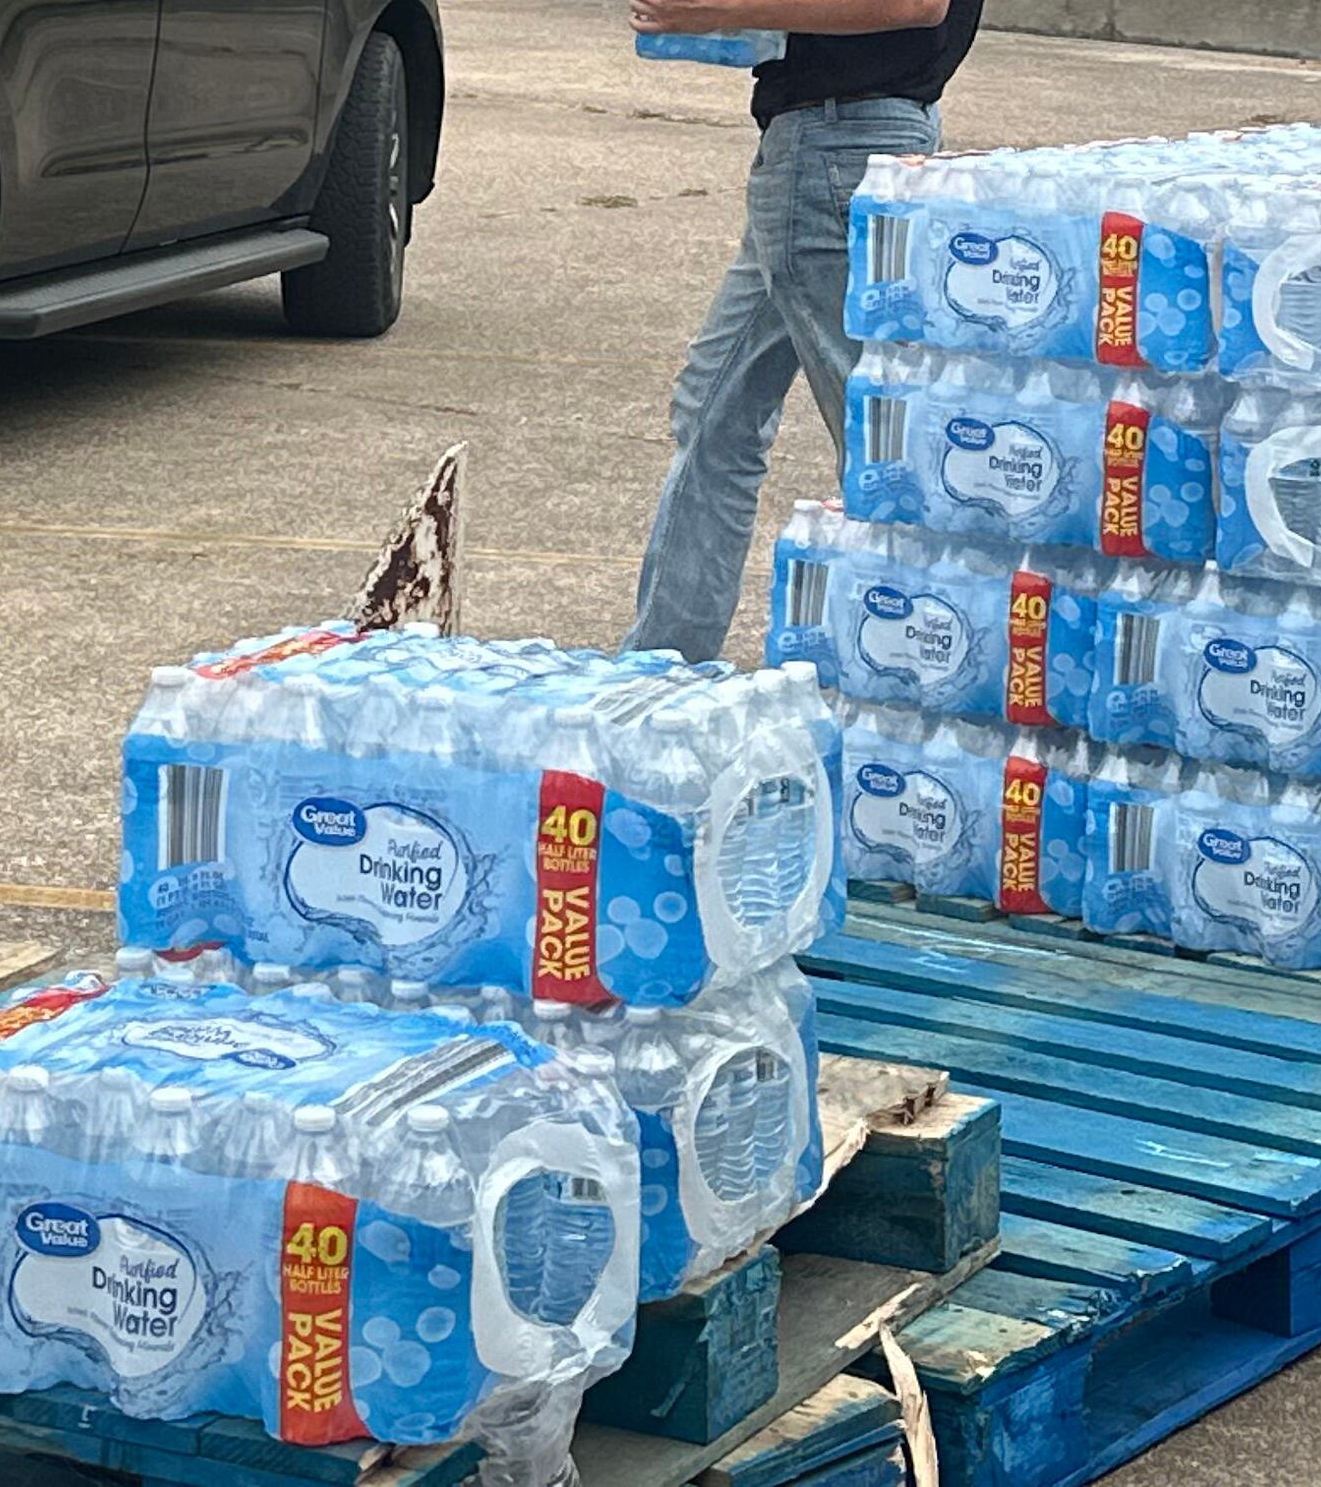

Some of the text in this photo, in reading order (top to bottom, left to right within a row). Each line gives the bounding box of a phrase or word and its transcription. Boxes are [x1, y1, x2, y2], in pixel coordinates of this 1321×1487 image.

[1102, 234, 1137, 260] 40
[1098, 287, 1115, 346] PACK
[1115, 286, 1133, 347] VALUE
[1107, 423, 1144, 450] 40
[1102, 478, 1119, 536] PACK
[1120, 476, 1138, 537] VALUE
[1013, 593, 1046, 620] 40
[1009, 648, 1025, 706] PACK
[1025, 647, 1042, 708] VALUE
[1006, 779, 1040, 806] 40
[301, 805, 356, 827] Great
[314, 824, 356, 837] Value
[541, 805, 596, 846] 40
[360, 855, 441, 891] Drinking
[1003, 834, 1018, 891] PACK
[1019, 833, 1035, 892] VALUE
[381, 883, 443, 910] Water
[538, 889, 563, 979] PACK
[565, 886, 590, 981] VALUE
[26, 1212, 88, 1237] Great
[41, 1232, 87, 1247] Value
[287, 1222, 348, 1265] 40
[120, 1255, 180, 1282] Purified
[283, 1265, 313, 1280] HALF
[290, 1278, 342, 1294] BOTTLES
[92, 1267, 177, 1315] Drinking
[113, 1301, 178, 1337] Water
[286, 1313, 312, 1411] PACK
[314, 1309, 342, 1412] VALUE
